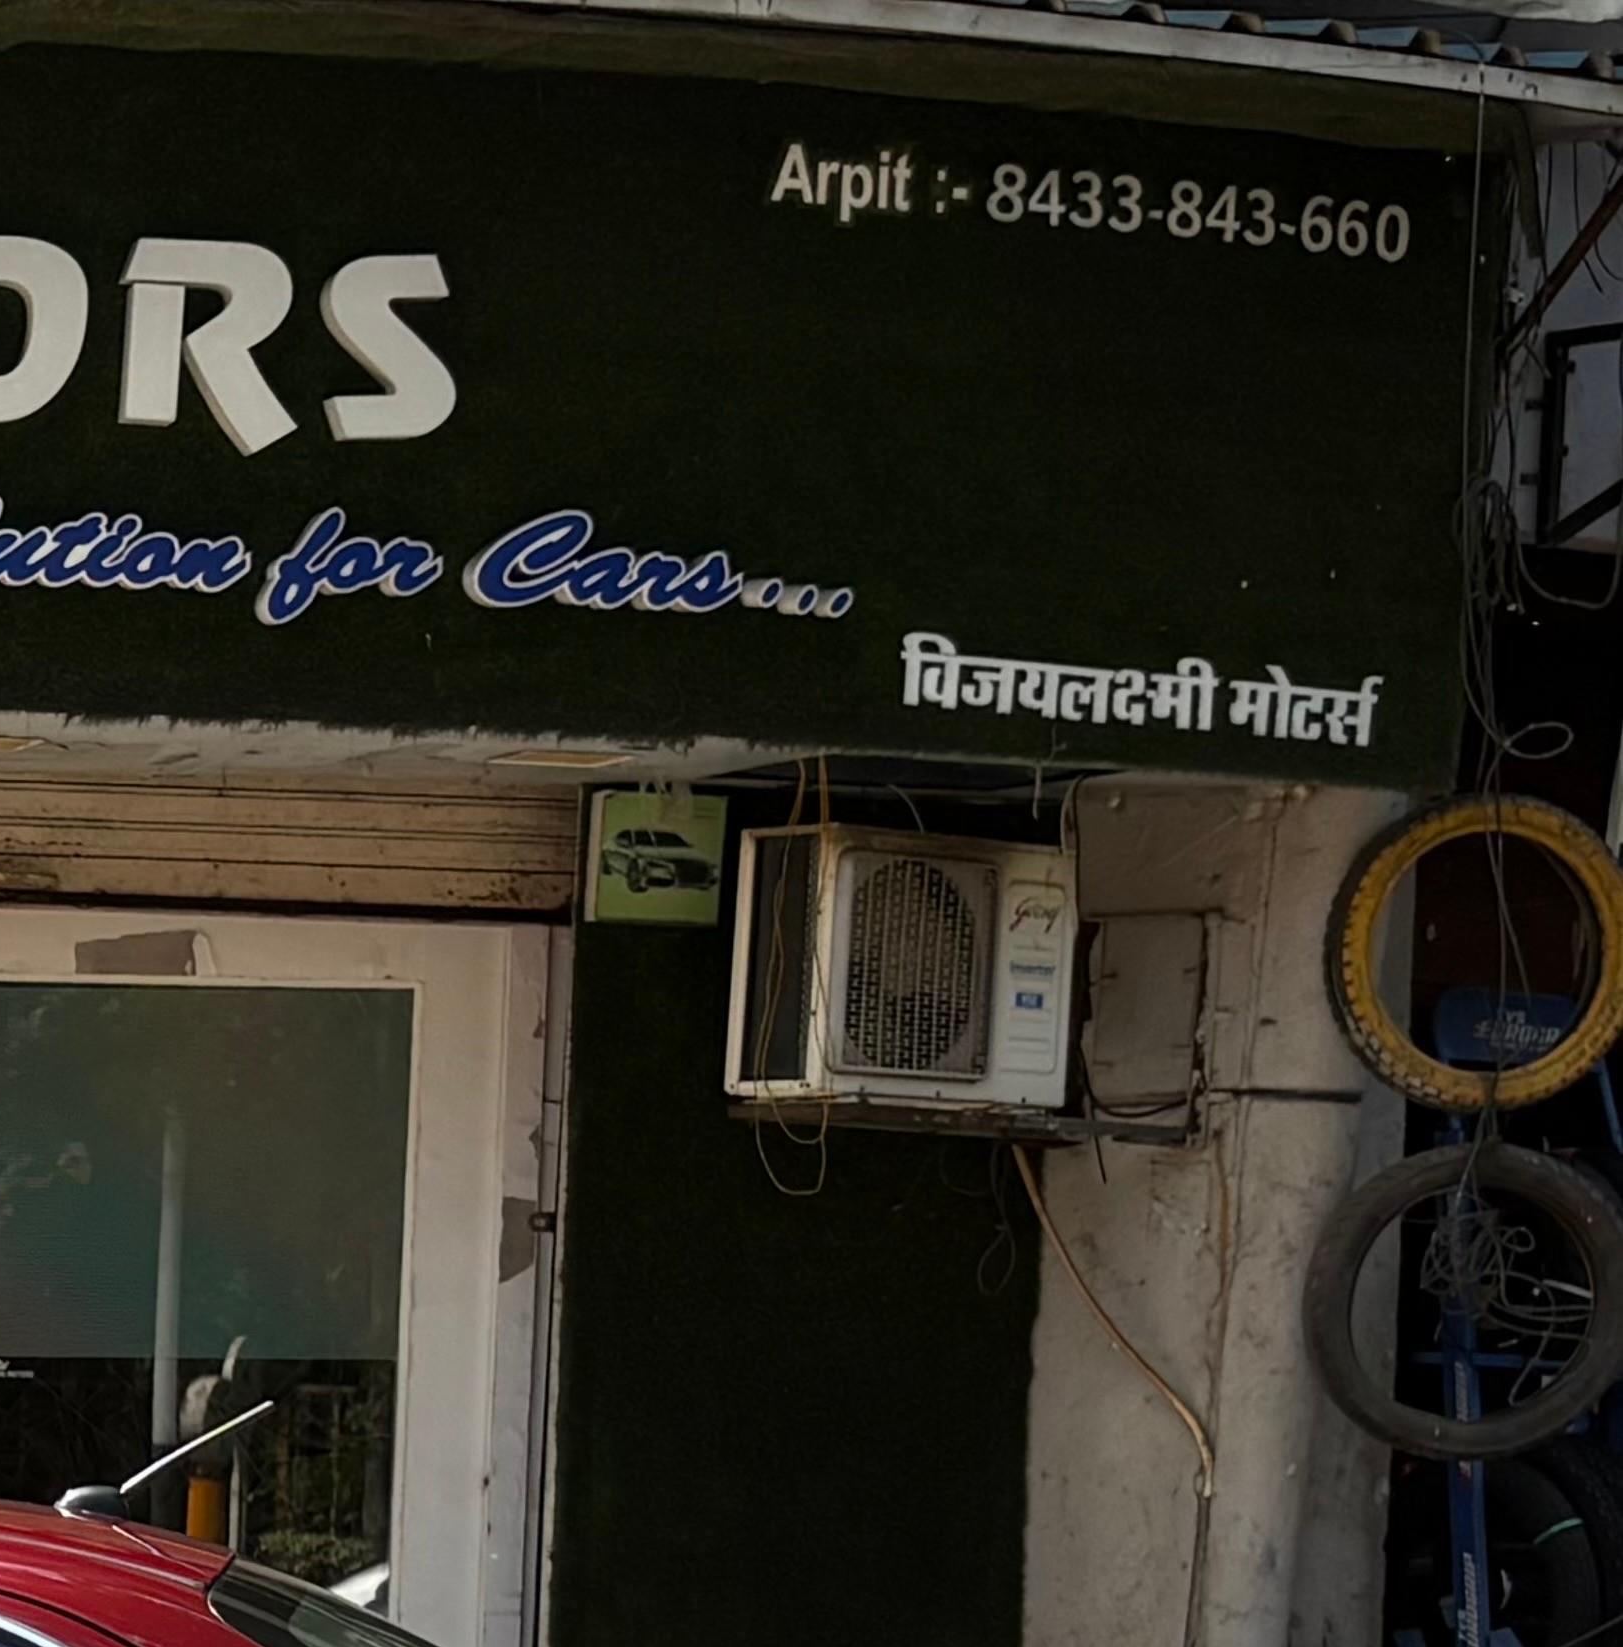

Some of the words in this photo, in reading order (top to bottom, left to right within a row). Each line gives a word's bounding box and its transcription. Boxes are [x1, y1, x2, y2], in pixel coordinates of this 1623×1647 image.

[769, 142, 911, 223] Arpit
[985, 162, 1411, 263] 8433-843-660
[255, 507, 443, 626] for
[900, 631, 1220, 732] विजयलक्ष्मी
[1228, 664, 1384, 748] मोटर्स
